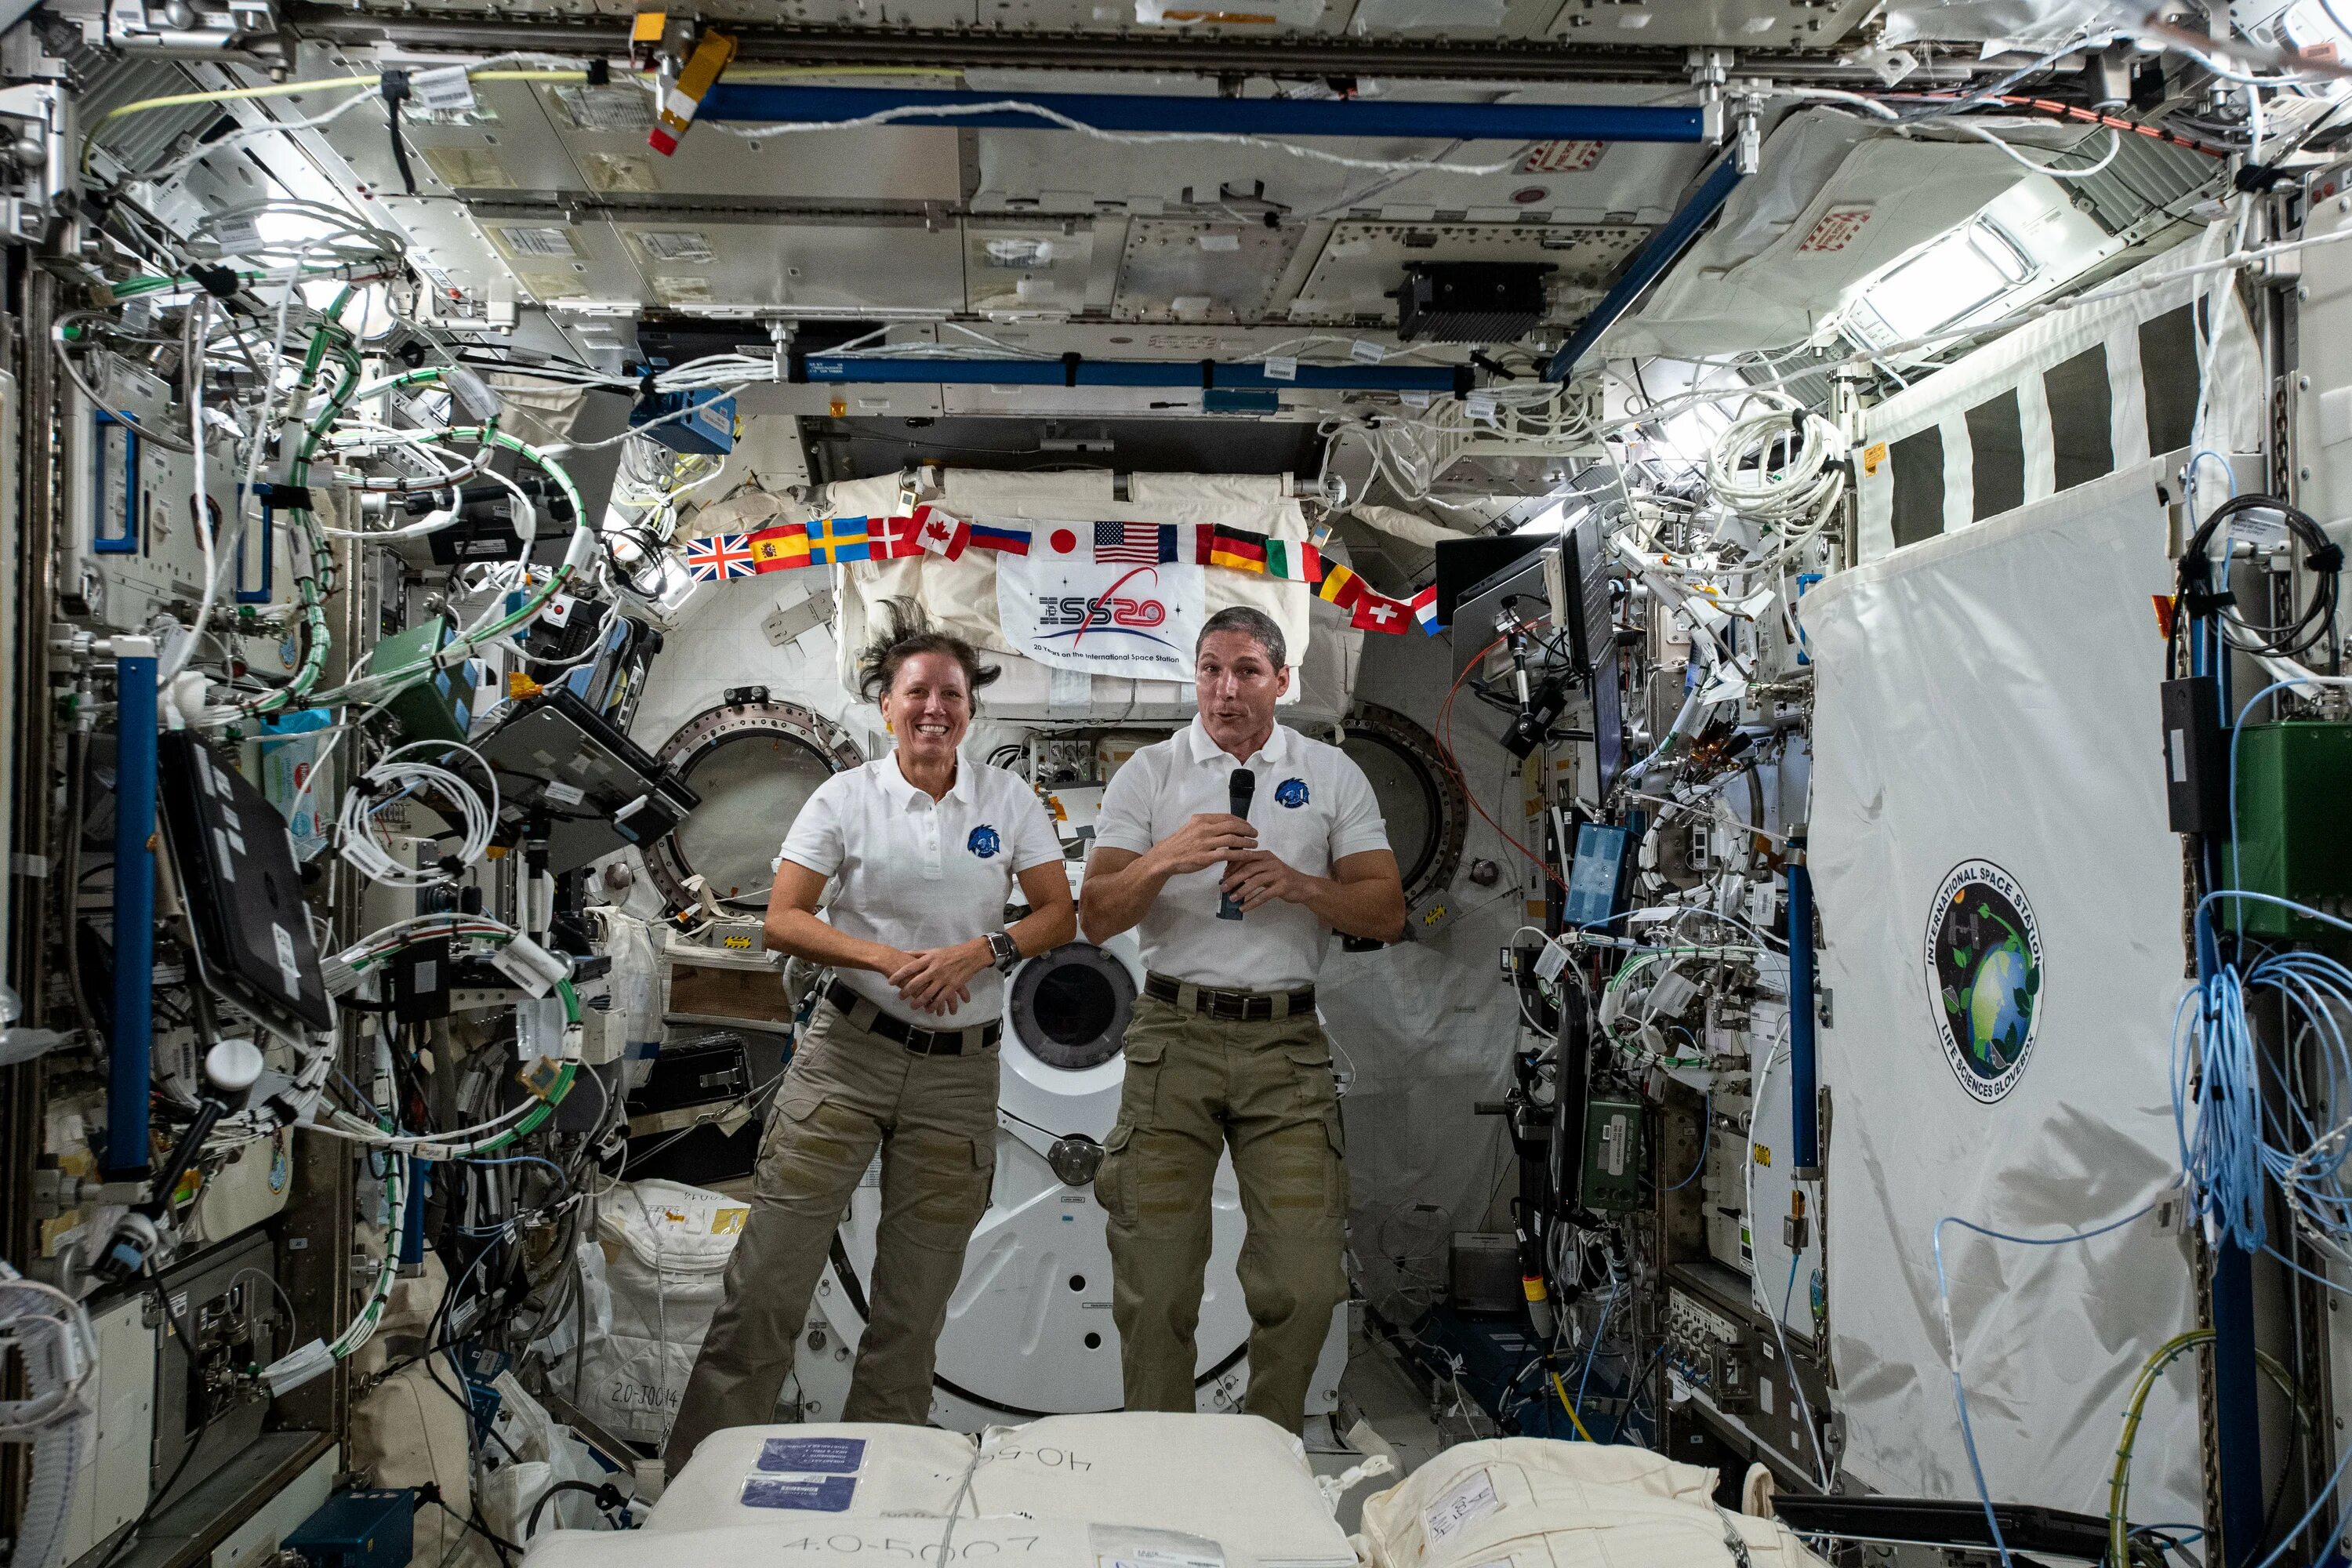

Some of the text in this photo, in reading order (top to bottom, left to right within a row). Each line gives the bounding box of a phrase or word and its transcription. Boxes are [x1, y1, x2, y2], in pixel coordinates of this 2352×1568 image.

[1043, 645, 1060, 657] Years
[1156, 655, 1180, 663] Station
[1927, 867, 2041, 969] INTERNATIONAL SPACE STATION
[1941, 1024, 2034, 1097] LIFE SCIENCES GLOVEBOX
